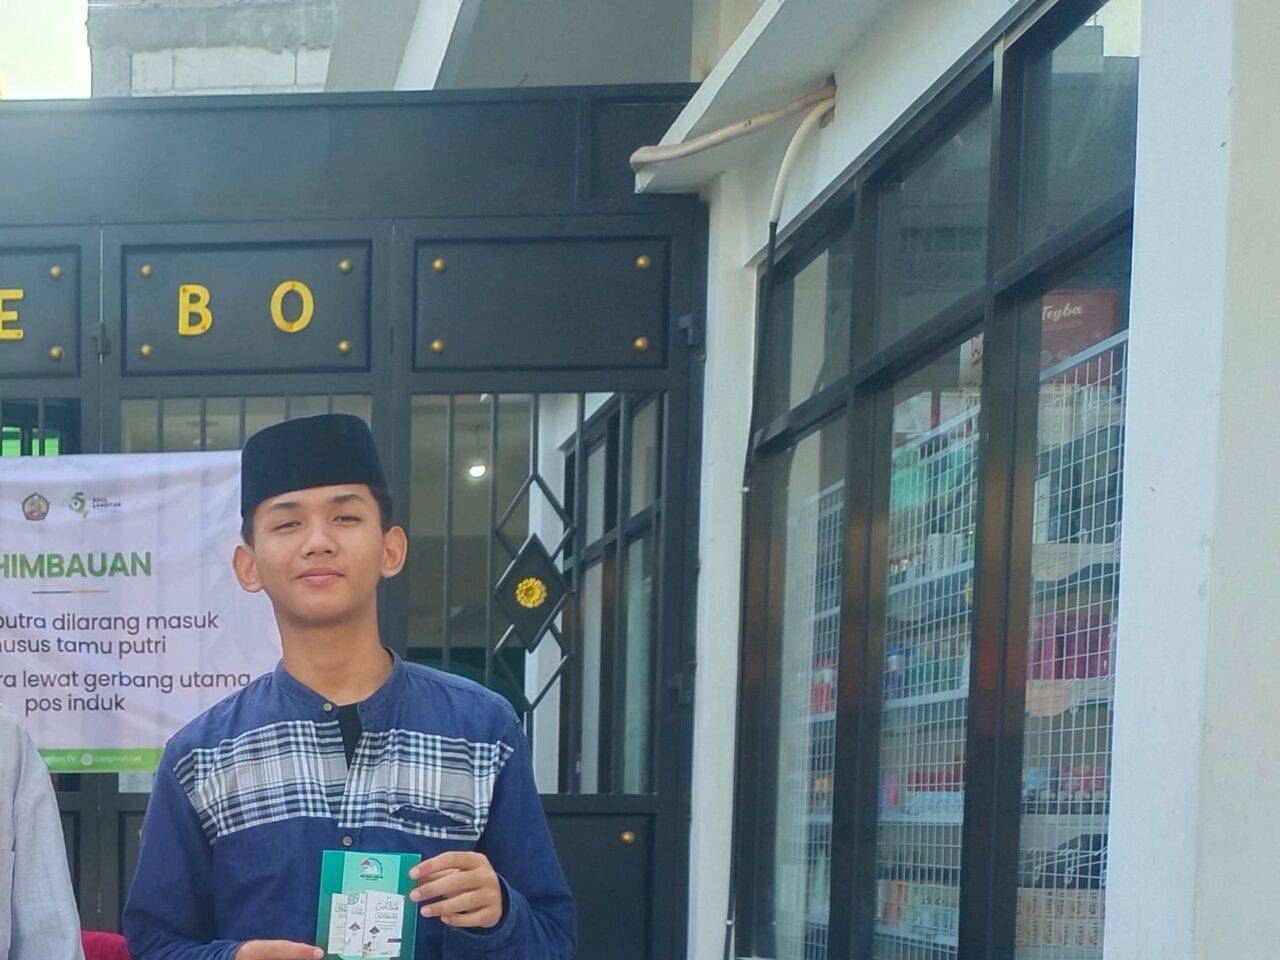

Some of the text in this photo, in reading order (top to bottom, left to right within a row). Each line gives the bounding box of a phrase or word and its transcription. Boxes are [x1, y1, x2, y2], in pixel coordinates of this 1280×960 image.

[52, 612, 140, 634] dilarang
[146, 611, 219, 629] masuk
[56, 638, 113, 654] tamu
[119, 636, 167, 659] putri
[22, 669, 78, 687] lewat
[83, 669, 174, 693] gerbang
[179, 671, 251, 687] utama
[25, 694, 127, 716] pos induk
